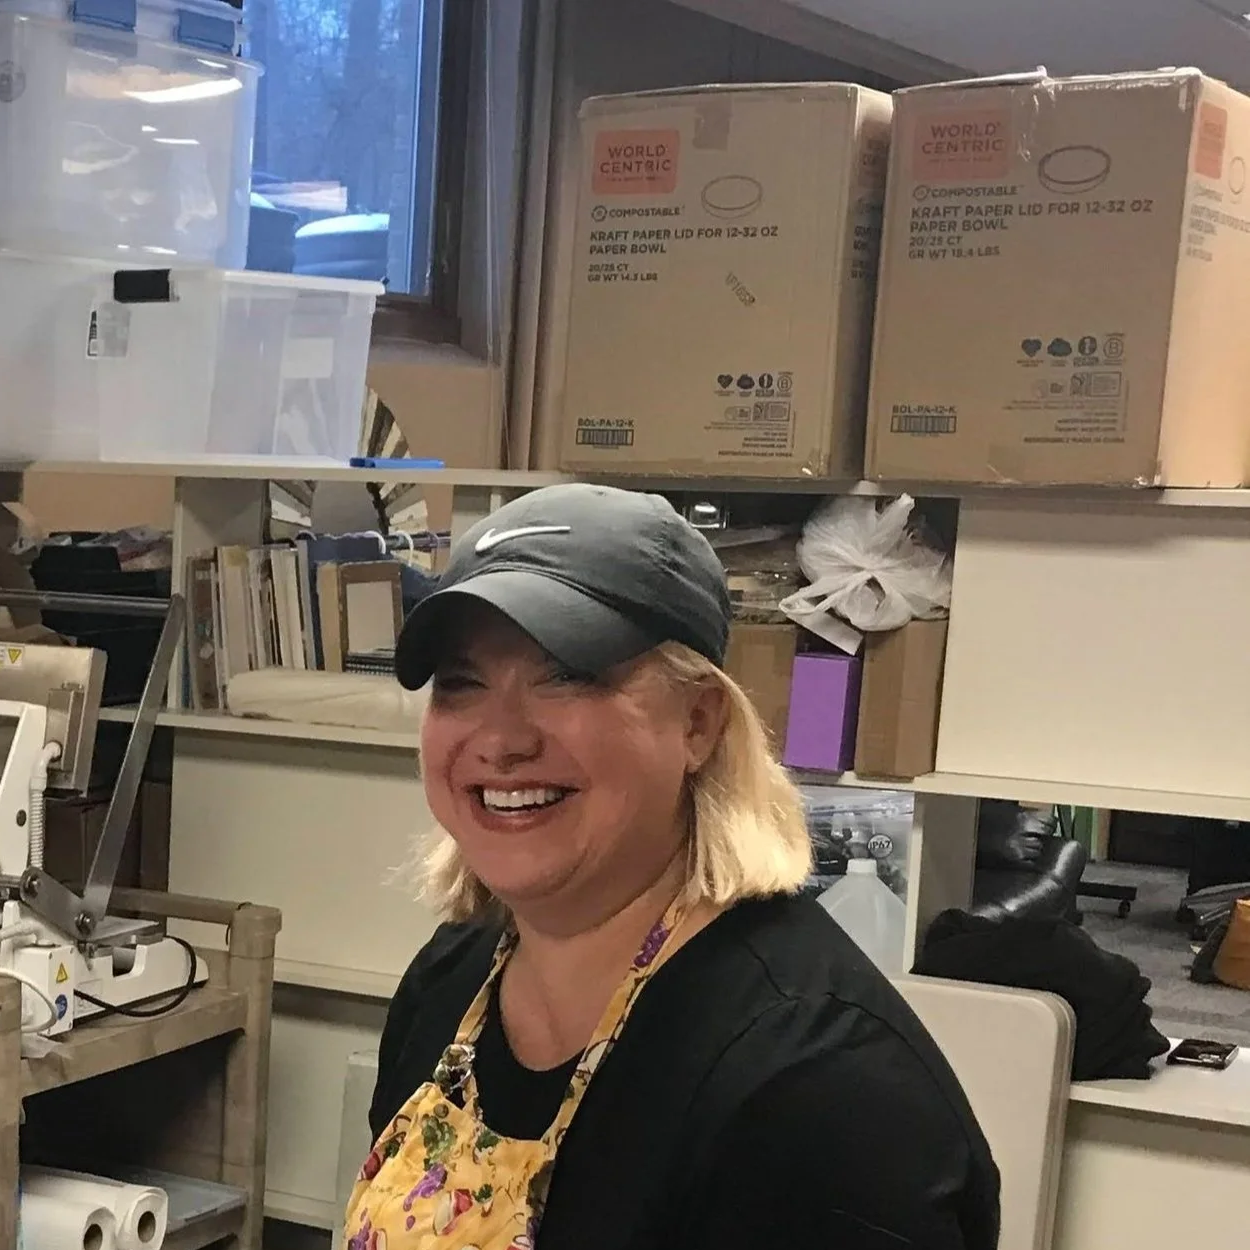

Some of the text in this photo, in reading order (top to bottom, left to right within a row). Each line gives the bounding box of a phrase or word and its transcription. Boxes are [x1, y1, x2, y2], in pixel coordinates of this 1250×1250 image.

[931, 122, 997, 139] WORLD
[608, 144, 666, 160] WORLD
[921, 139, 1006, 155] CENTRIC
[600, 159, 672, 174] CENTRIC
[931, 185, 1019, 198] COMPOSTABLE
[609, 207, 681, 219] COMPOSTABLE
[911, 199, 1153, 219] KRAFT PAPER LID FOR 12-32 OZ
[910, 218, 1009, 233] PAPER BOWL
[590, 225, 779, 242] KRAFT PAPER LID FOR 12-32 OZ
[947, 236, 963, 246] CT
[589, 243, 667, 256] PAPER BOWL
[908, 249, 924, 260] GR
[928, 249, 947, 260] WT
[978, 246, 1000, 257] LBS
[617, 263, 629, 272] CT
[603, 273, 618, 282] WT
[640, 272, 658, 281] LBS
